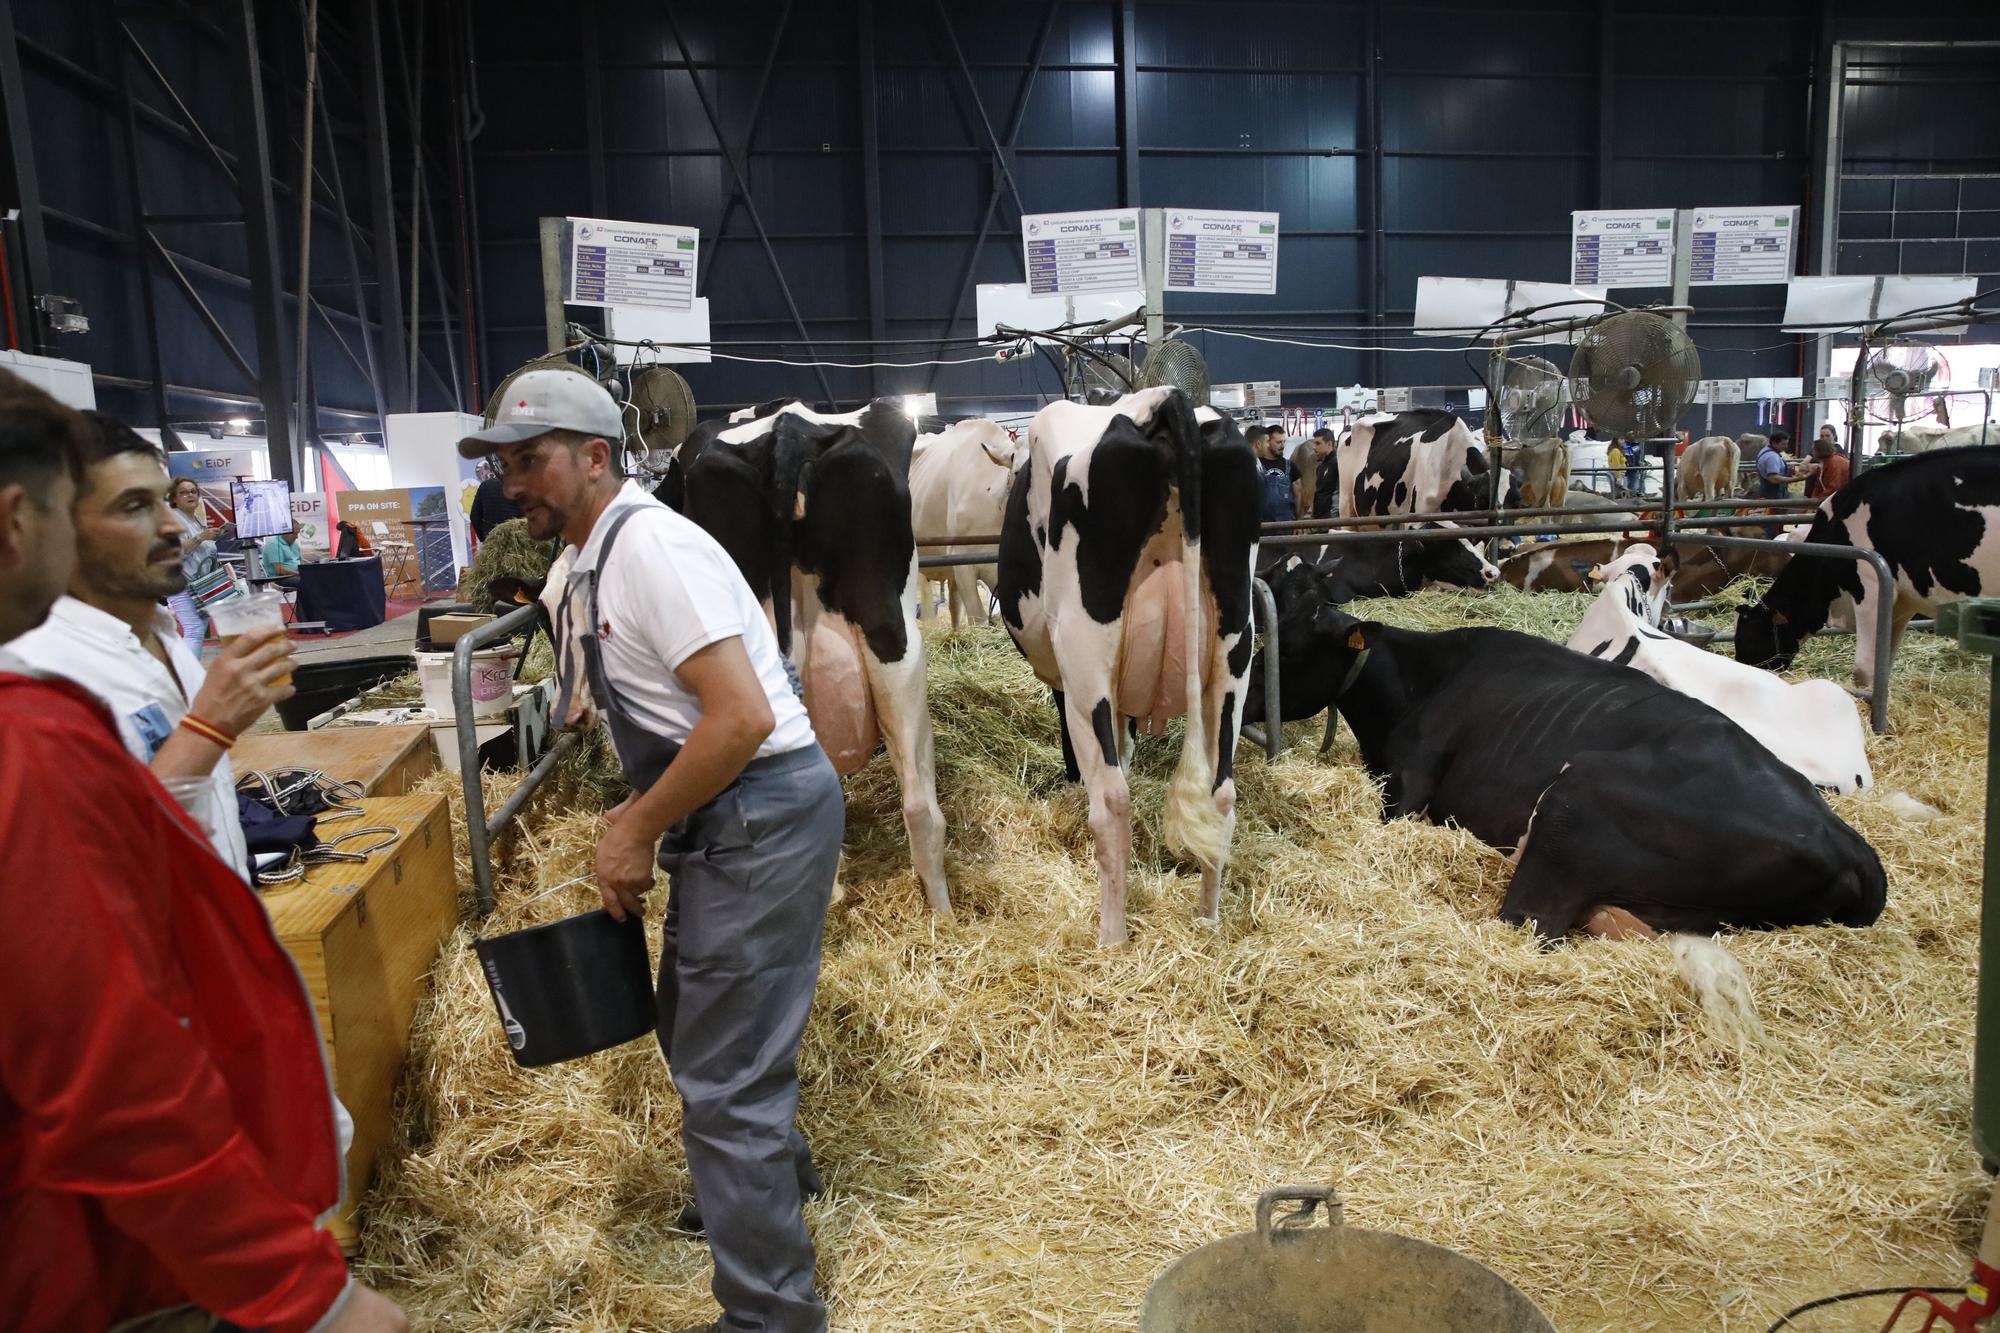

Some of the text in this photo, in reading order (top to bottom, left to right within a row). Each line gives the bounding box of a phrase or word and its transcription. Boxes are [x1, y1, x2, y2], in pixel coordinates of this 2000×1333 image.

[1061, 224, 1101, 233] CONAFE
[614, 235, 657, 244] CONAFE
[205, 458, 232, 468] EiDF
